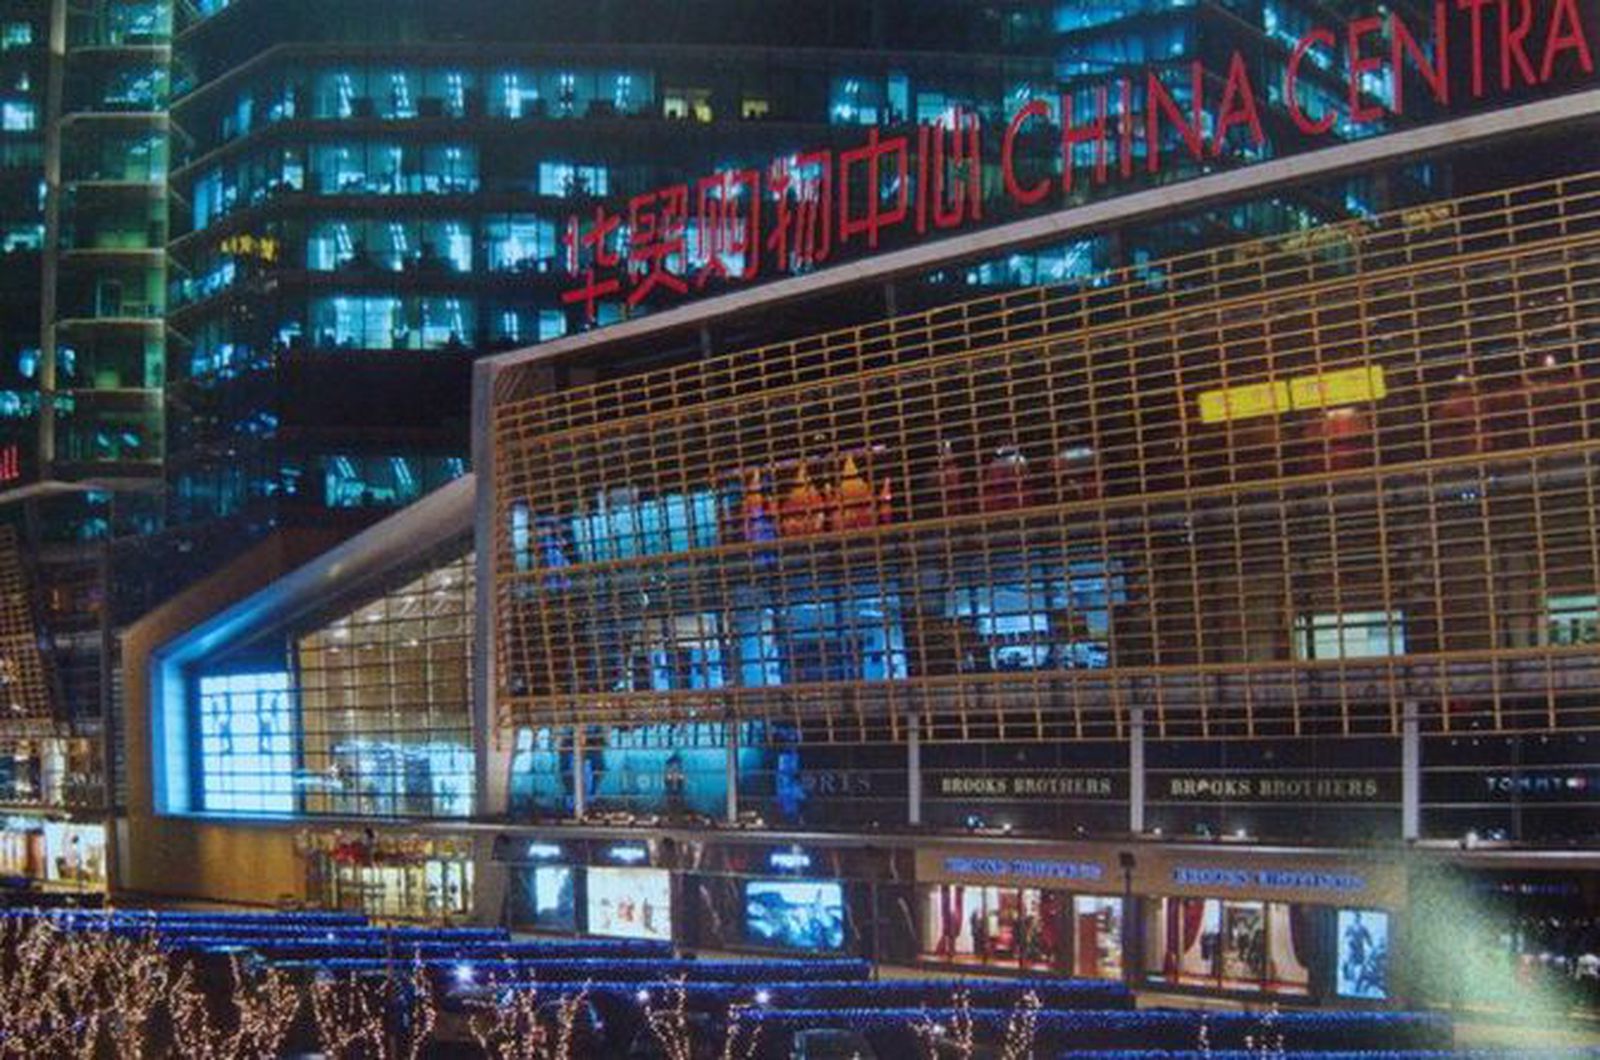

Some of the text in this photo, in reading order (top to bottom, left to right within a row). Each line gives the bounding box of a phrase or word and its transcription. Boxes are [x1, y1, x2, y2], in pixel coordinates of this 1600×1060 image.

[1002, 0, 1594, 205] CHINA CENTRA
[941, 777, 1112, 794] BROOKS BROTHERS
[1170, 778, 1378, 797] BROOKS BROTHERS
